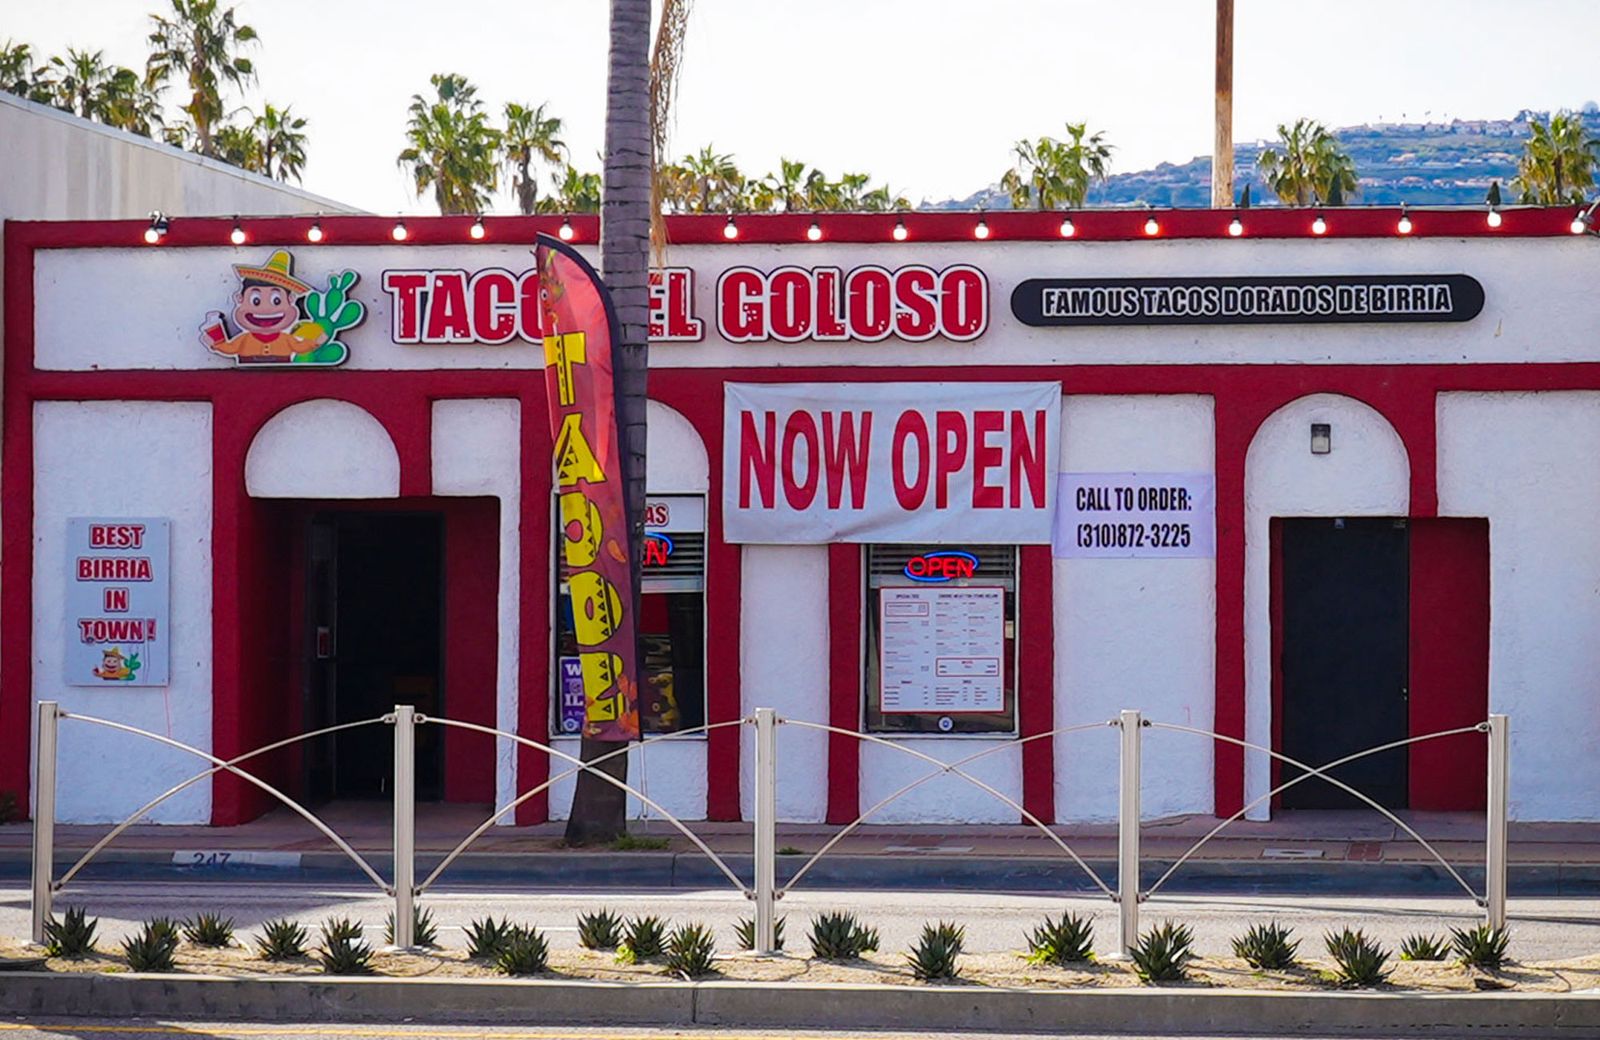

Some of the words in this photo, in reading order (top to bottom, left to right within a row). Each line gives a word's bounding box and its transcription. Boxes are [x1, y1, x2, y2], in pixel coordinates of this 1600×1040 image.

[717, 264, 988, 342] GOLOSO
[1043, 288, 1139, 316] FAMOUS
[1141, 287, 1219, 315] TACOS
[1221, 285, 1334, 315] DORADOS
[1336, 285, 1368, 313] DE
[1370, 284, 1452, 313] BIRRIA
[738, 409, 872, 511] NOW
[892, 409, 1046, 511] OPEN
[1076, 487, 1111, 511] CALL
[1115, 487, 1134, 511] TO
[1138, 487, 1192, 511] ORDER:
[90, 525, 144, 548] BEST
[1077, 523, 1191, 548] (310)872-3225
[77, 557, 153, 581] BIRRIA
[908, 556, 974, 578] OPEN
[104, 588, 129, 611] IN
